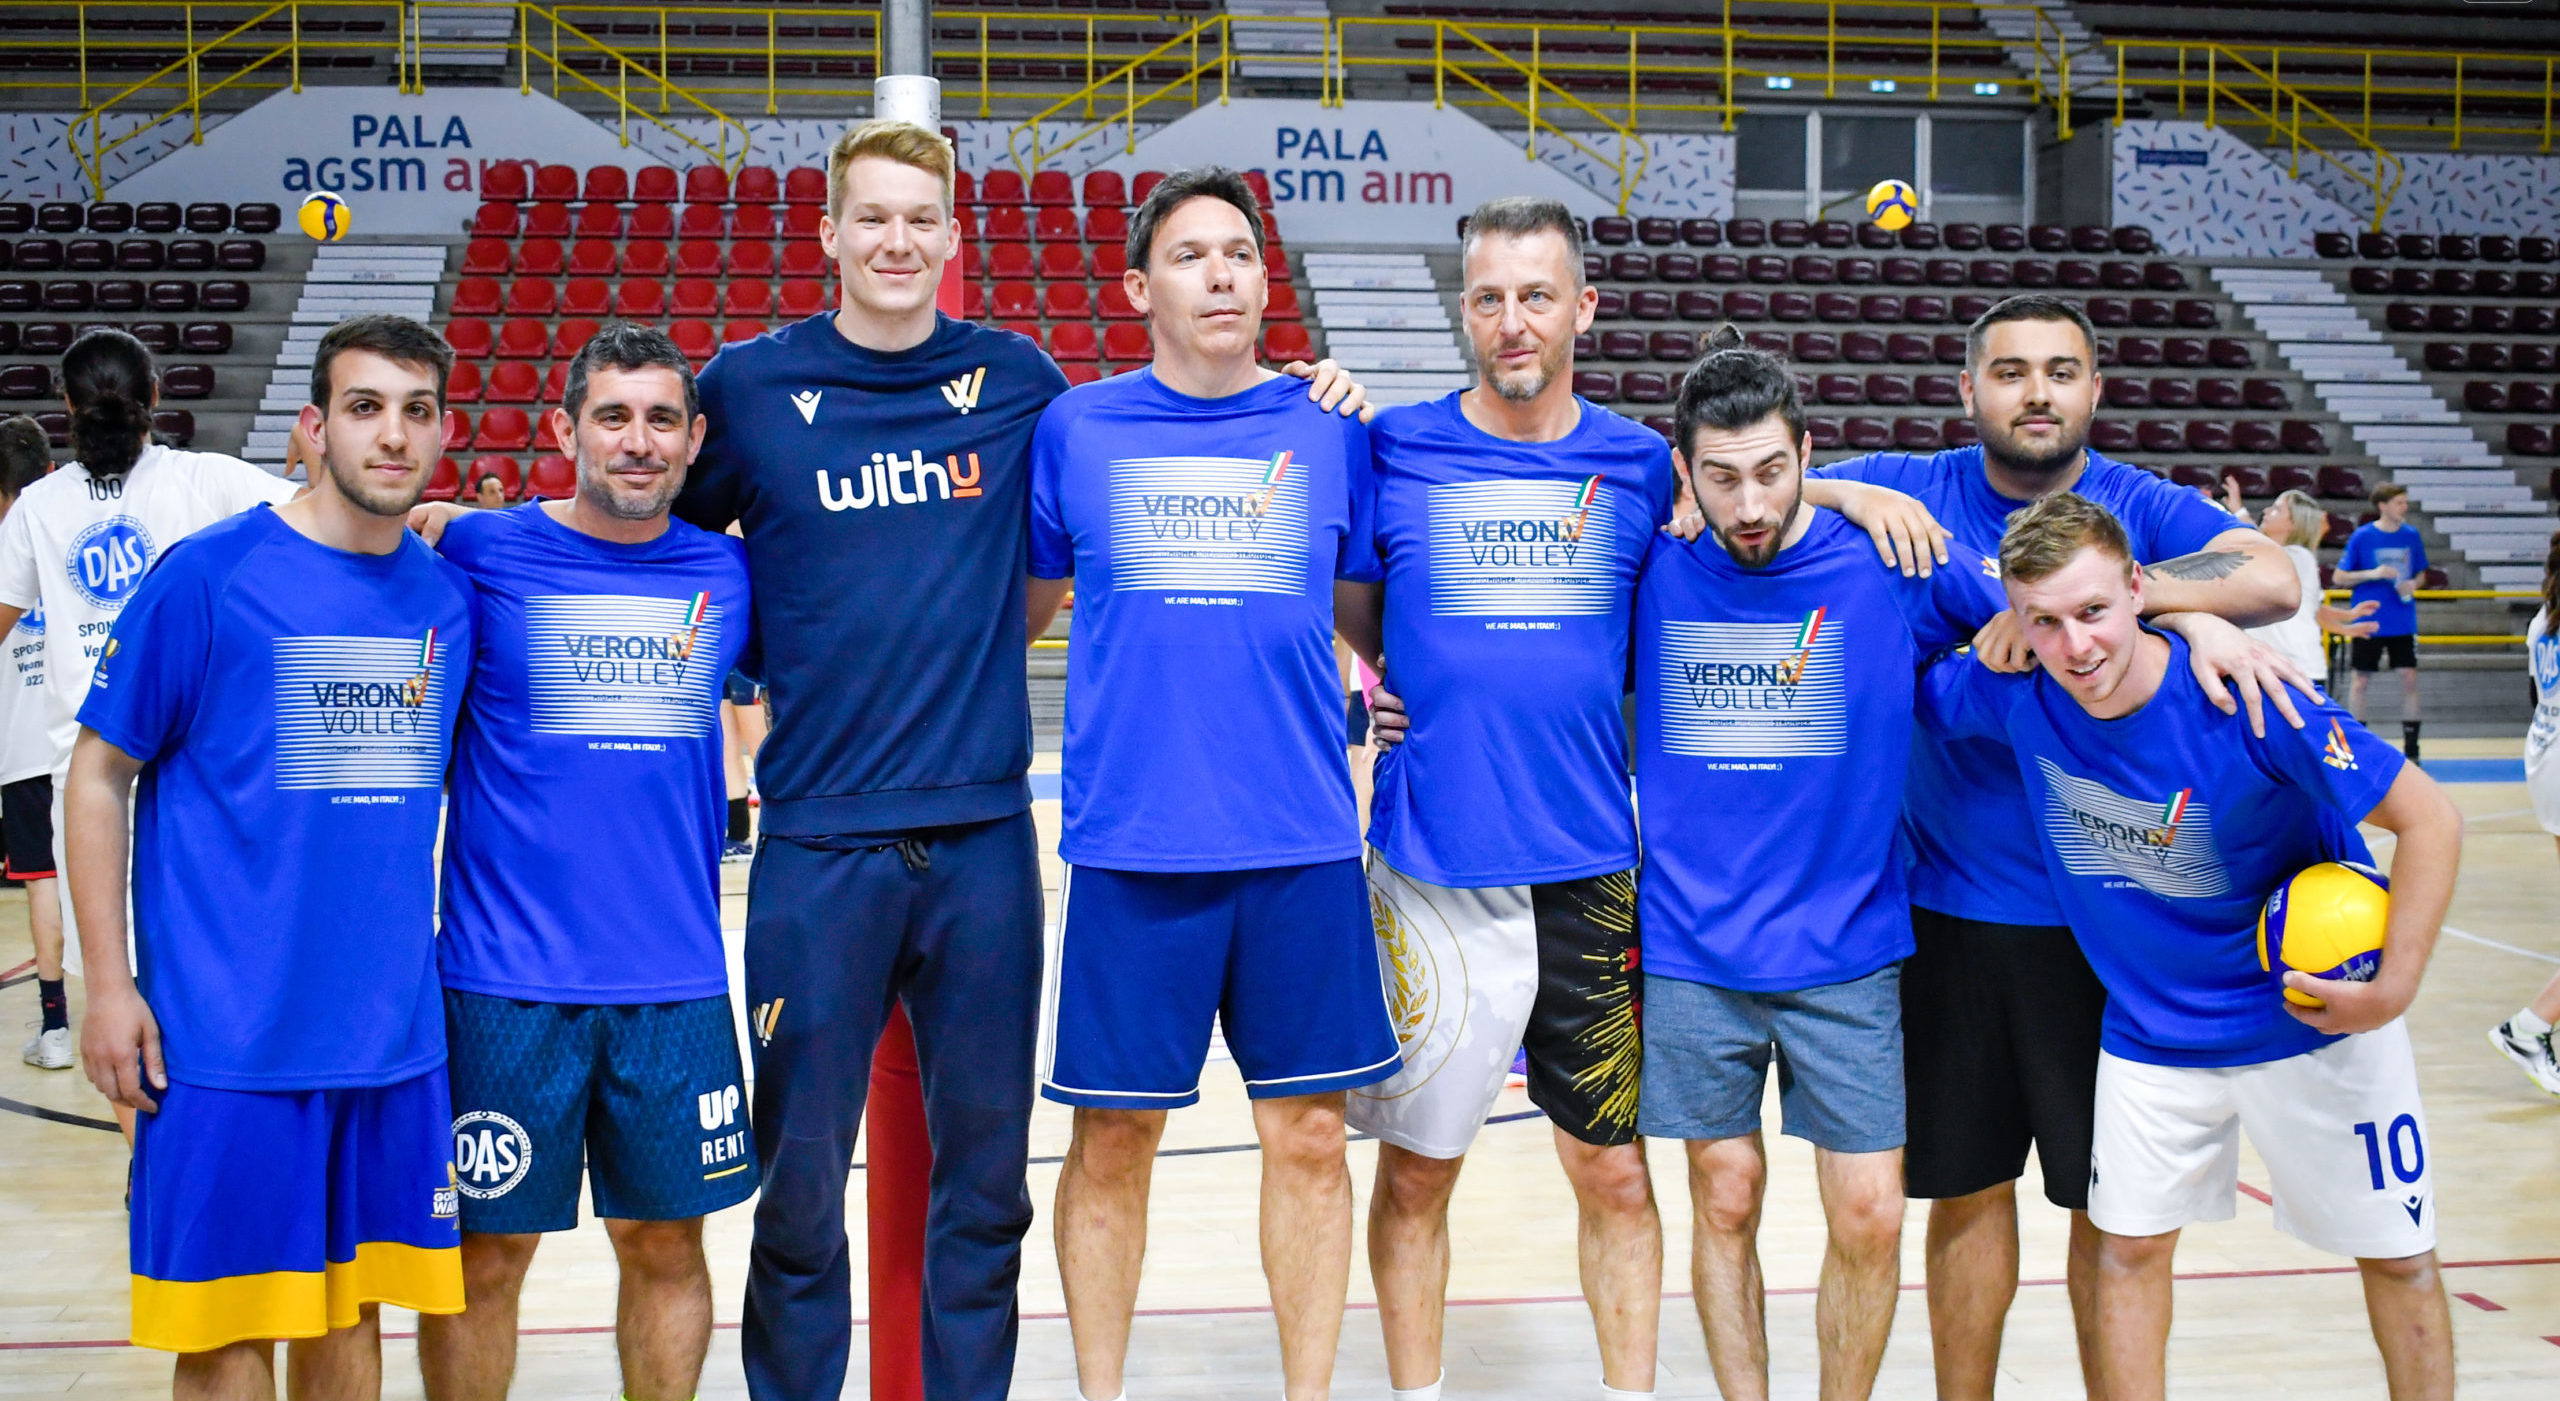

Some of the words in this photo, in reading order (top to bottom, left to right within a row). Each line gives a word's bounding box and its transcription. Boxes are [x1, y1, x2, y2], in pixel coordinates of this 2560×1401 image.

[353, 115, 472, 148] PALA
[1277, 127, 1388, 161] PALA
[1362, 171, 1453, 203] aim
[84, 478, 122, 501] 100
[1151, 519, 1263, 541] VOLLEY
[84, 535, 144, 592] DAS
[1470, 543, 1577, 566] VOLLEY
[1176, 597, 1189, 605] ARE
[1485, 622, 1497, 630] WE
[1497, 622, 1509, 630] ARE
[574, 660, 687, 685] VOLLEY
[1691, 687, 1797, 710] VOLLEY
[321, 709, 421, 734] VOLLEY
[588, 742, 600, 750] WE
[600, 742, 613, 750] ARE
[1707, 763, 1719, 771] WE
[1718, 763, 1730, 771] ARE
[698, 1084, 740, 1131] UP
[457, 1129, 518, 1182] DAS
[701, 1130, 745, 1166] RENT
[2354, 1113, 2424, 1190] 10
